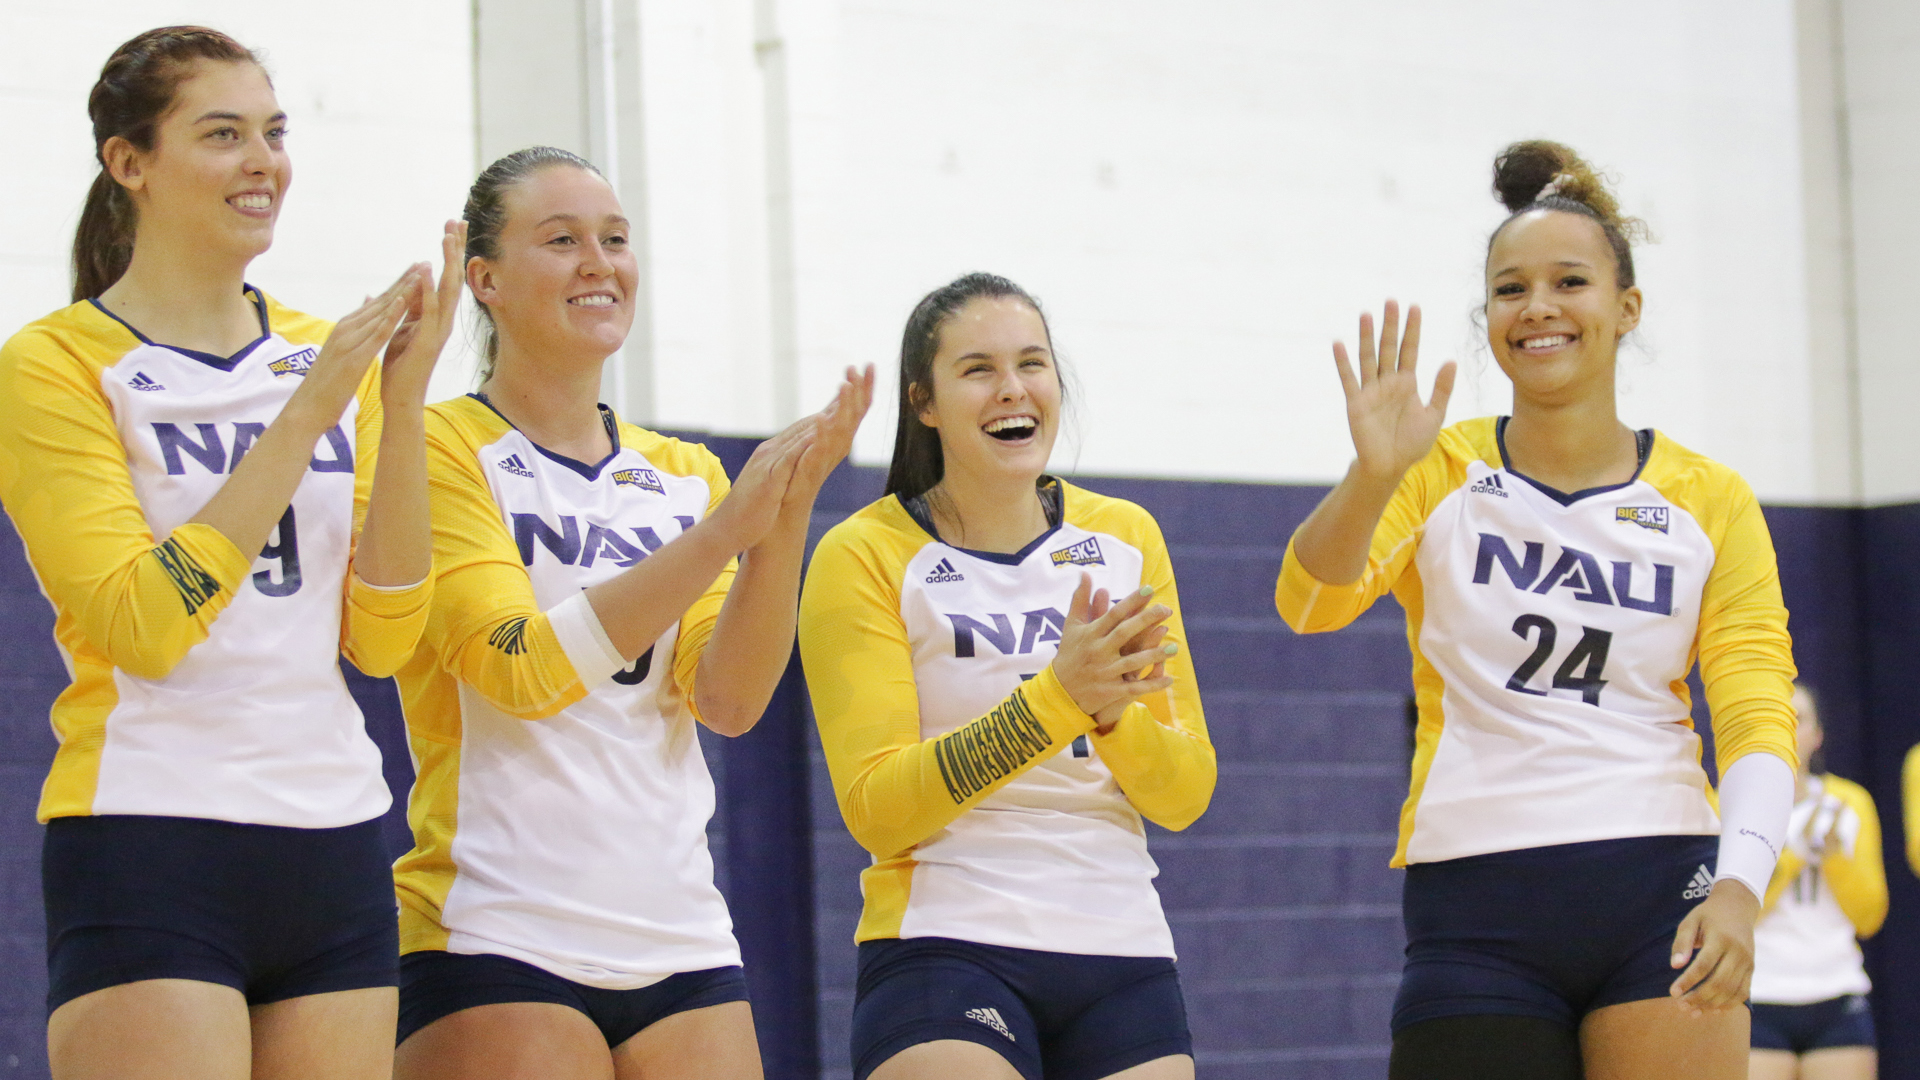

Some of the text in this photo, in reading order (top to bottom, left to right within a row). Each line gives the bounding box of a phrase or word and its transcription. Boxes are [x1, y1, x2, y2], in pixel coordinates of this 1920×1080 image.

[498, 461, 534, 479] adidas
[1471, 484, 1509, 498] adidas
[925, 571, 964, 584] adidas
[1472, 532, 1675, 616] NAU
[1505, 613, 1613, 707] 24
[1683, 886, 1711, 900] adid
[965, 1010, 1016, 1042] adidas
